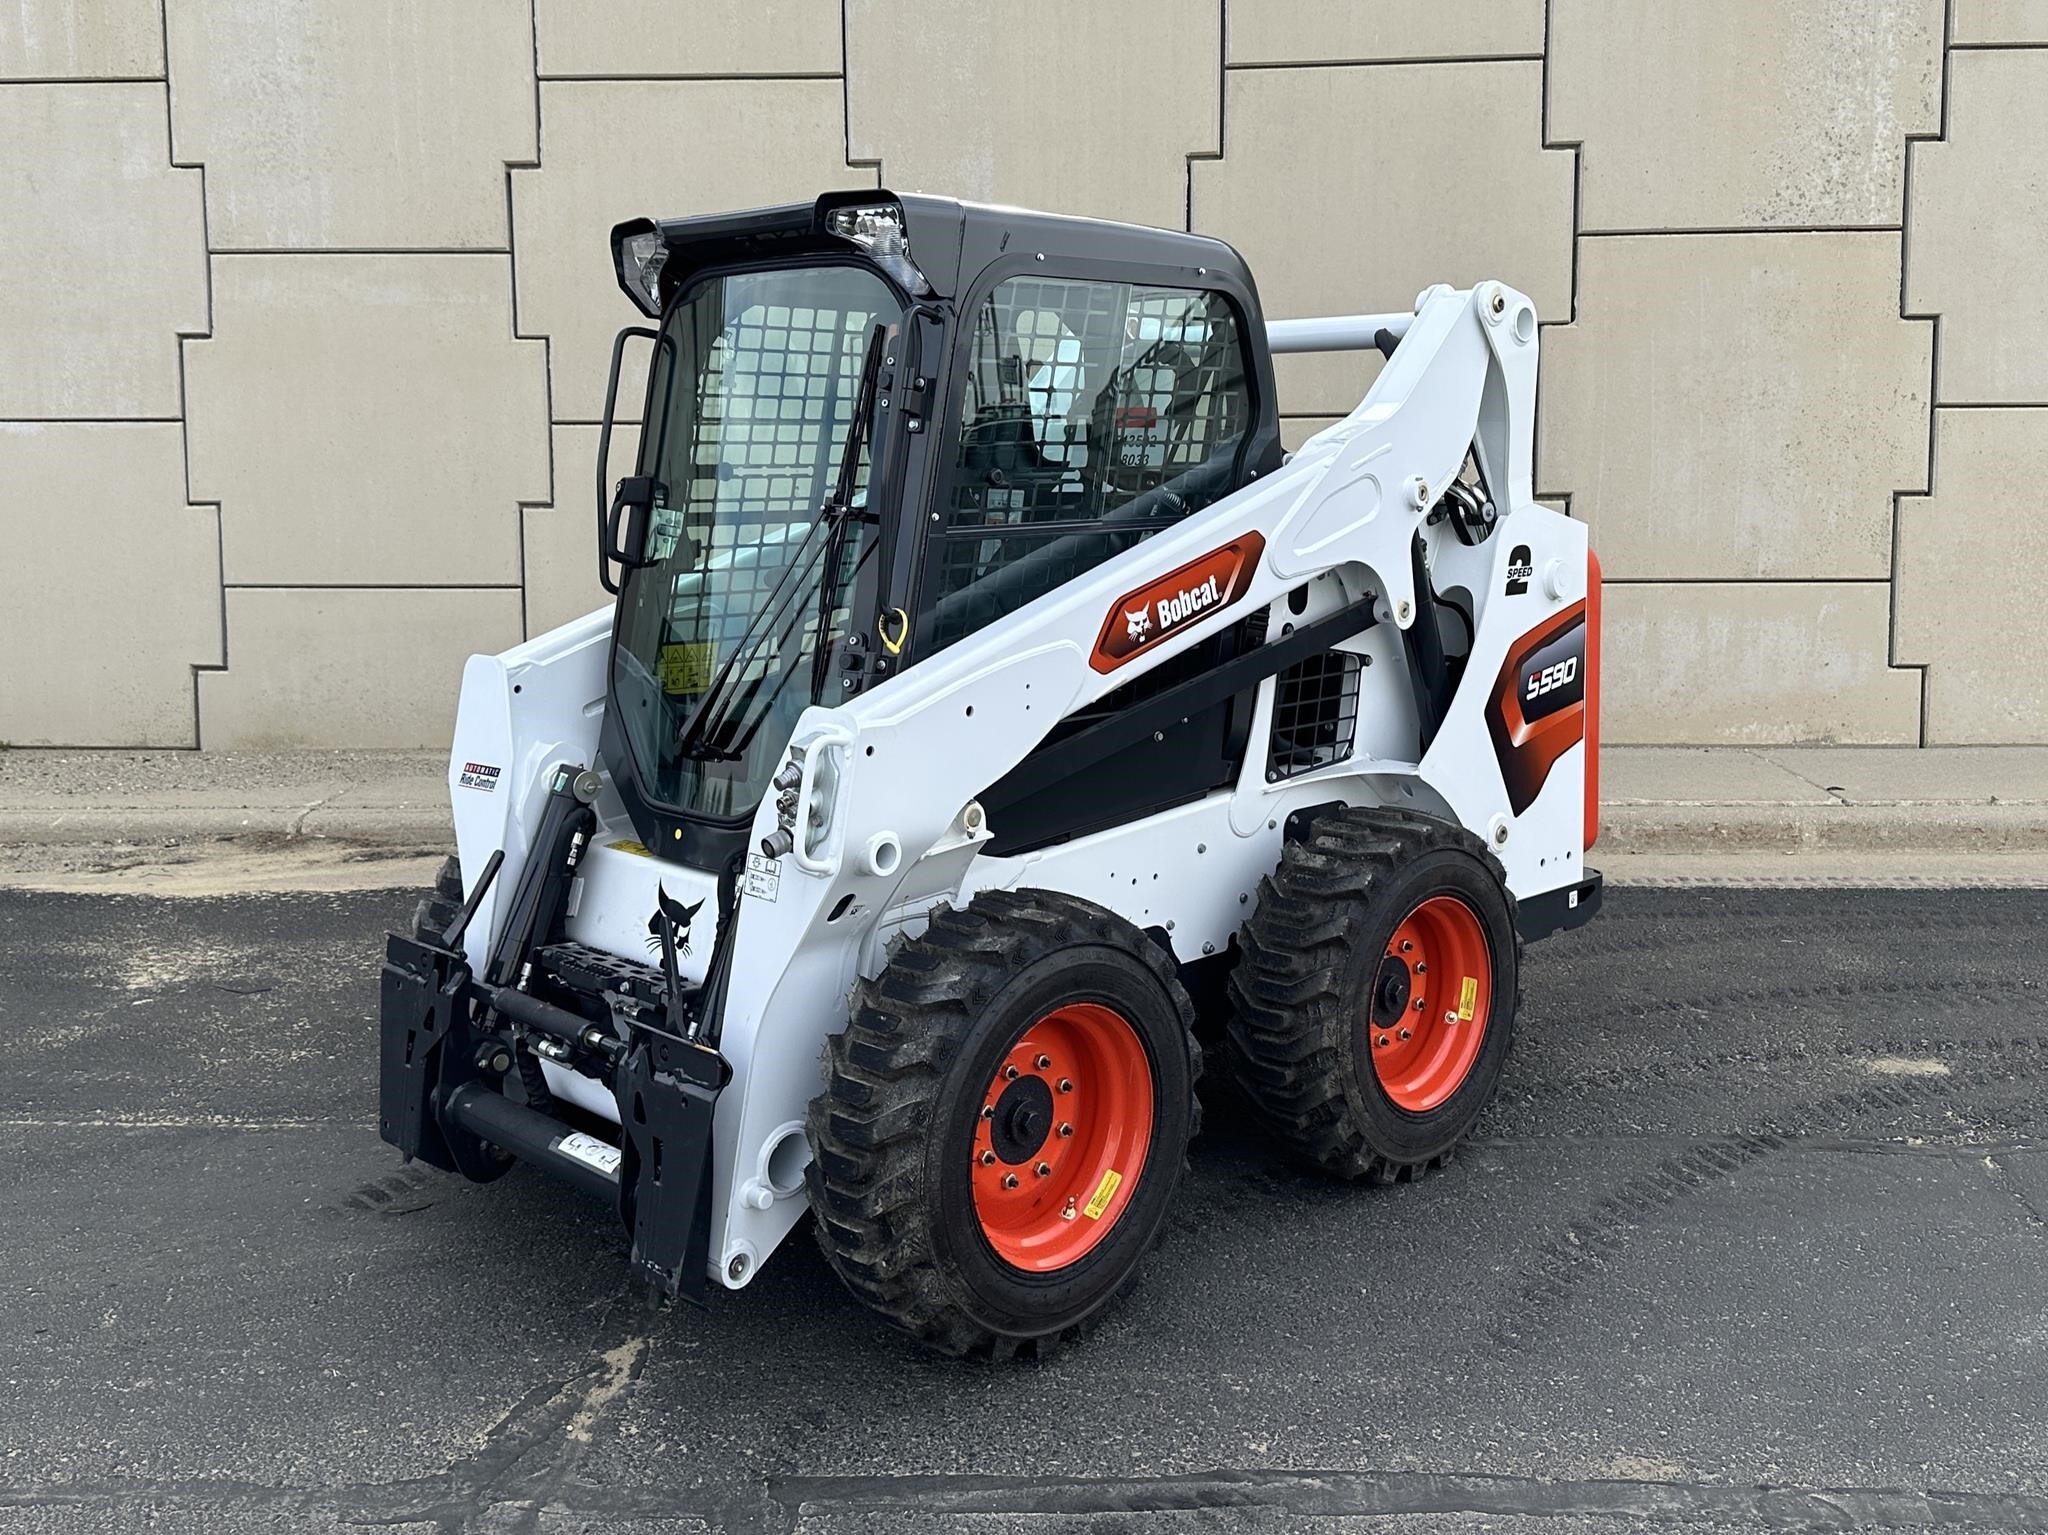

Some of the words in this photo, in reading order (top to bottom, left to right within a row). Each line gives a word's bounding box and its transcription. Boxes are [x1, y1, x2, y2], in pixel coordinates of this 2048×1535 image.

[1505, 544, 1531, 596] 2
[1507, 567, 1533, 579] SPEED
[1157, 574, 1219, 629] Bobcat
[1526, 656, 1578, 701] S590
[459, 773, 475, 785] Ride
[474, 775, 497, 789] Control
[465, 763, 500, 777] AUTOMATIC
